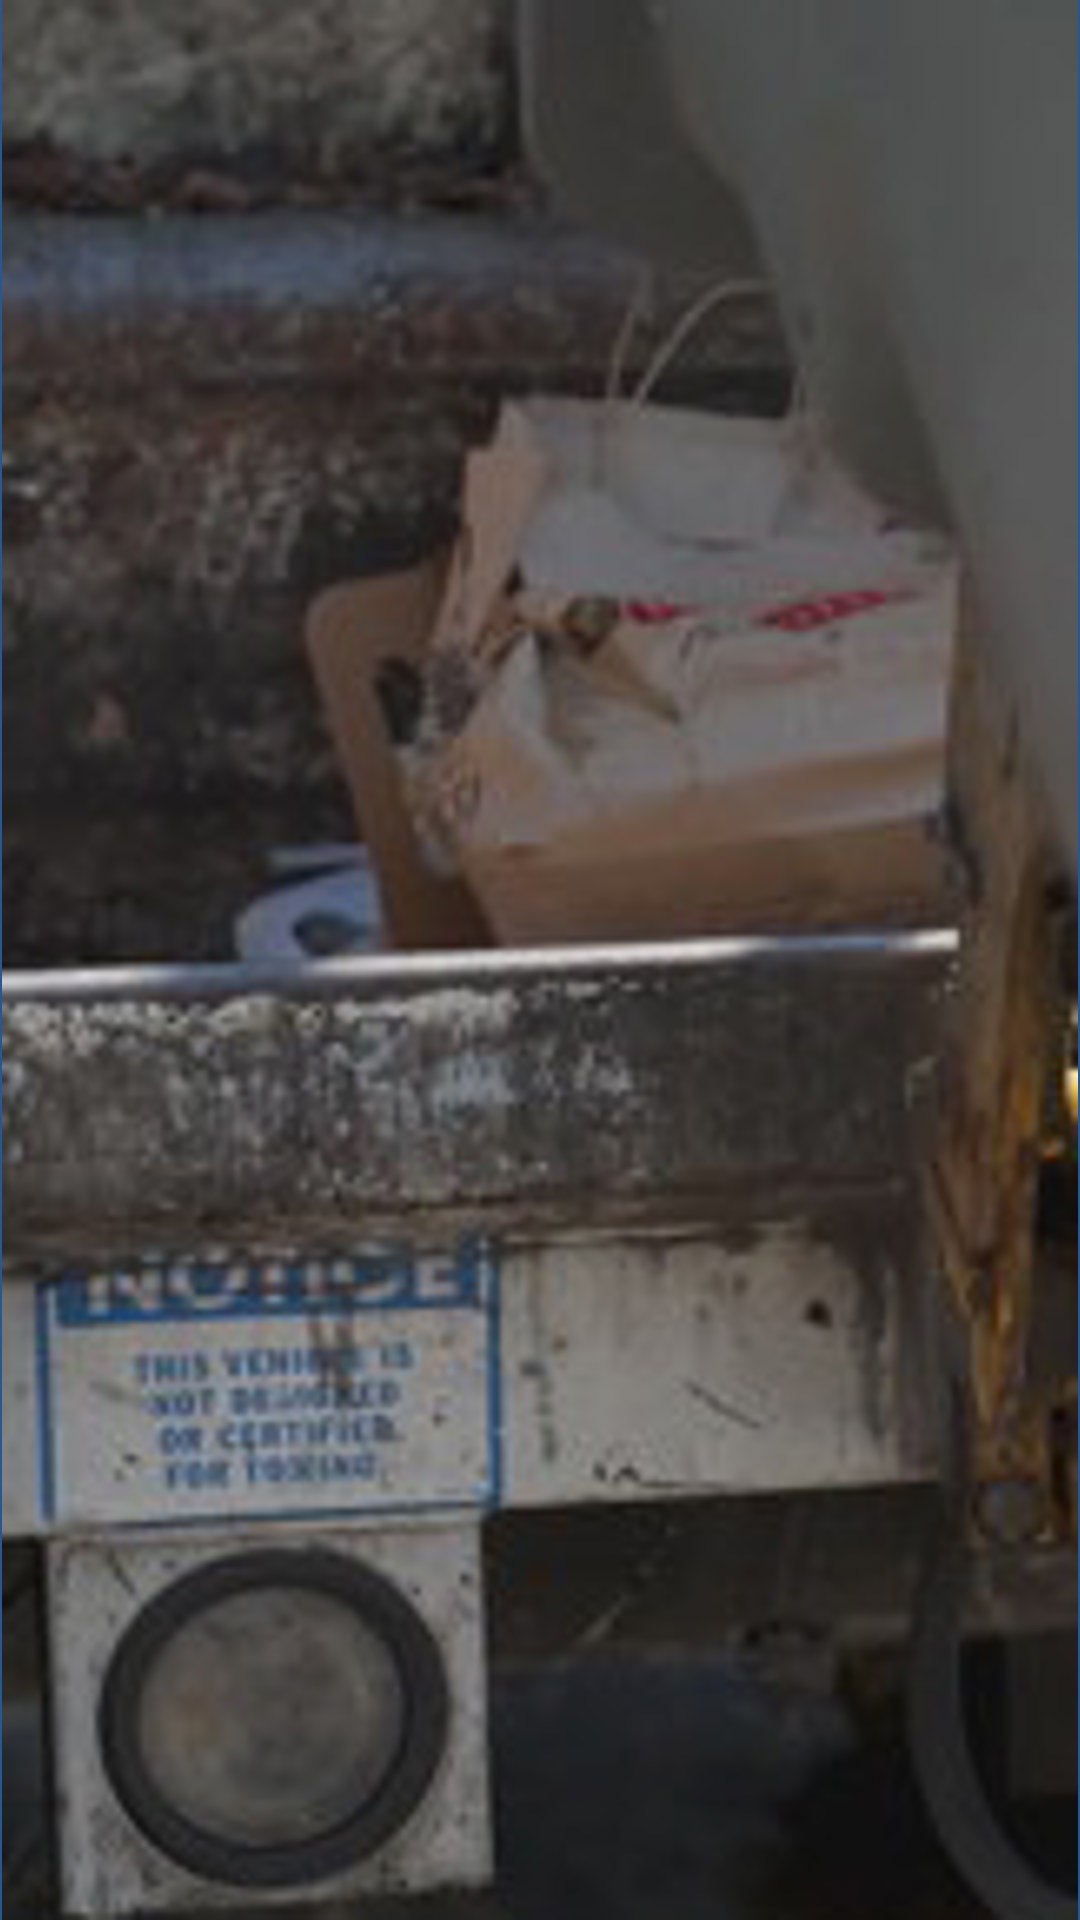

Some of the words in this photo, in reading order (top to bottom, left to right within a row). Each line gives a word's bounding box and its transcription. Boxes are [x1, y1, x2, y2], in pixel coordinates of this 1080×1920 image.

[133, 1350, 210, 1383] THIS
[379, 1340, 416, 1370] IS
[147, 1388, 216, 1418] NOT
[231, 1380, 400, 1416] DESIGNED
[158, 1427, 204, 1455] OR
[165, 1460, 229, 1489] FOR
